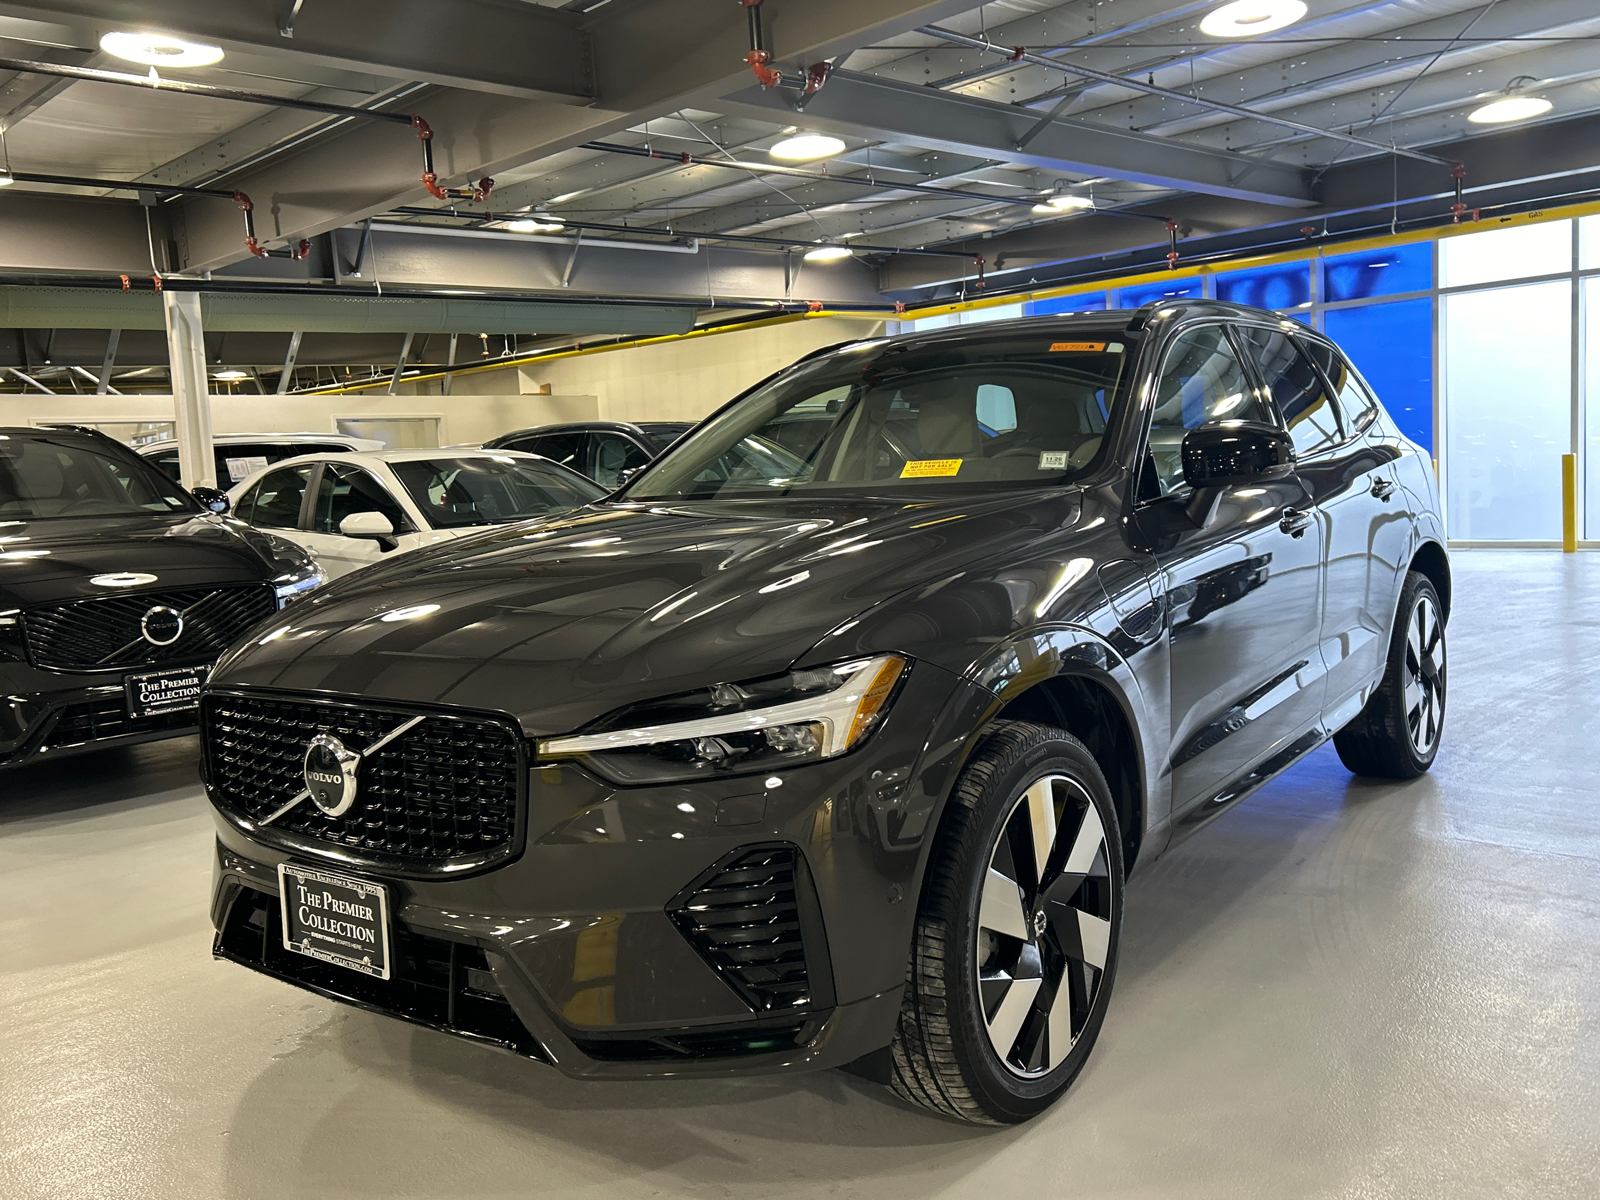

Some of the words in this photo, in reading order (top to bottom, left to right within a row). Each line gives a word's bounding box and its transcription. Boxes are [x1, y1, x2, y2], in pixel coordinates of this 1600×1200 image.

[138, 682, 160, 693] THE
[160, 677, 200, 690] PREMIER
[140, 686, 201, 703] COLLECTION
[307, 770, 342, 784] VOLVO
[285, 867, 316, 880] AUTOMOTIVE
[316, 872, 346, 886] EXCELLENCE
[362, 885, 377, 895] 1995
[296, 885, 322, 909] THE
[322, 891, 375, 922] PREMIER
[298, 906, 375, 944] COLLECTION
[310, 931, 336, 943] EVERYTHING
